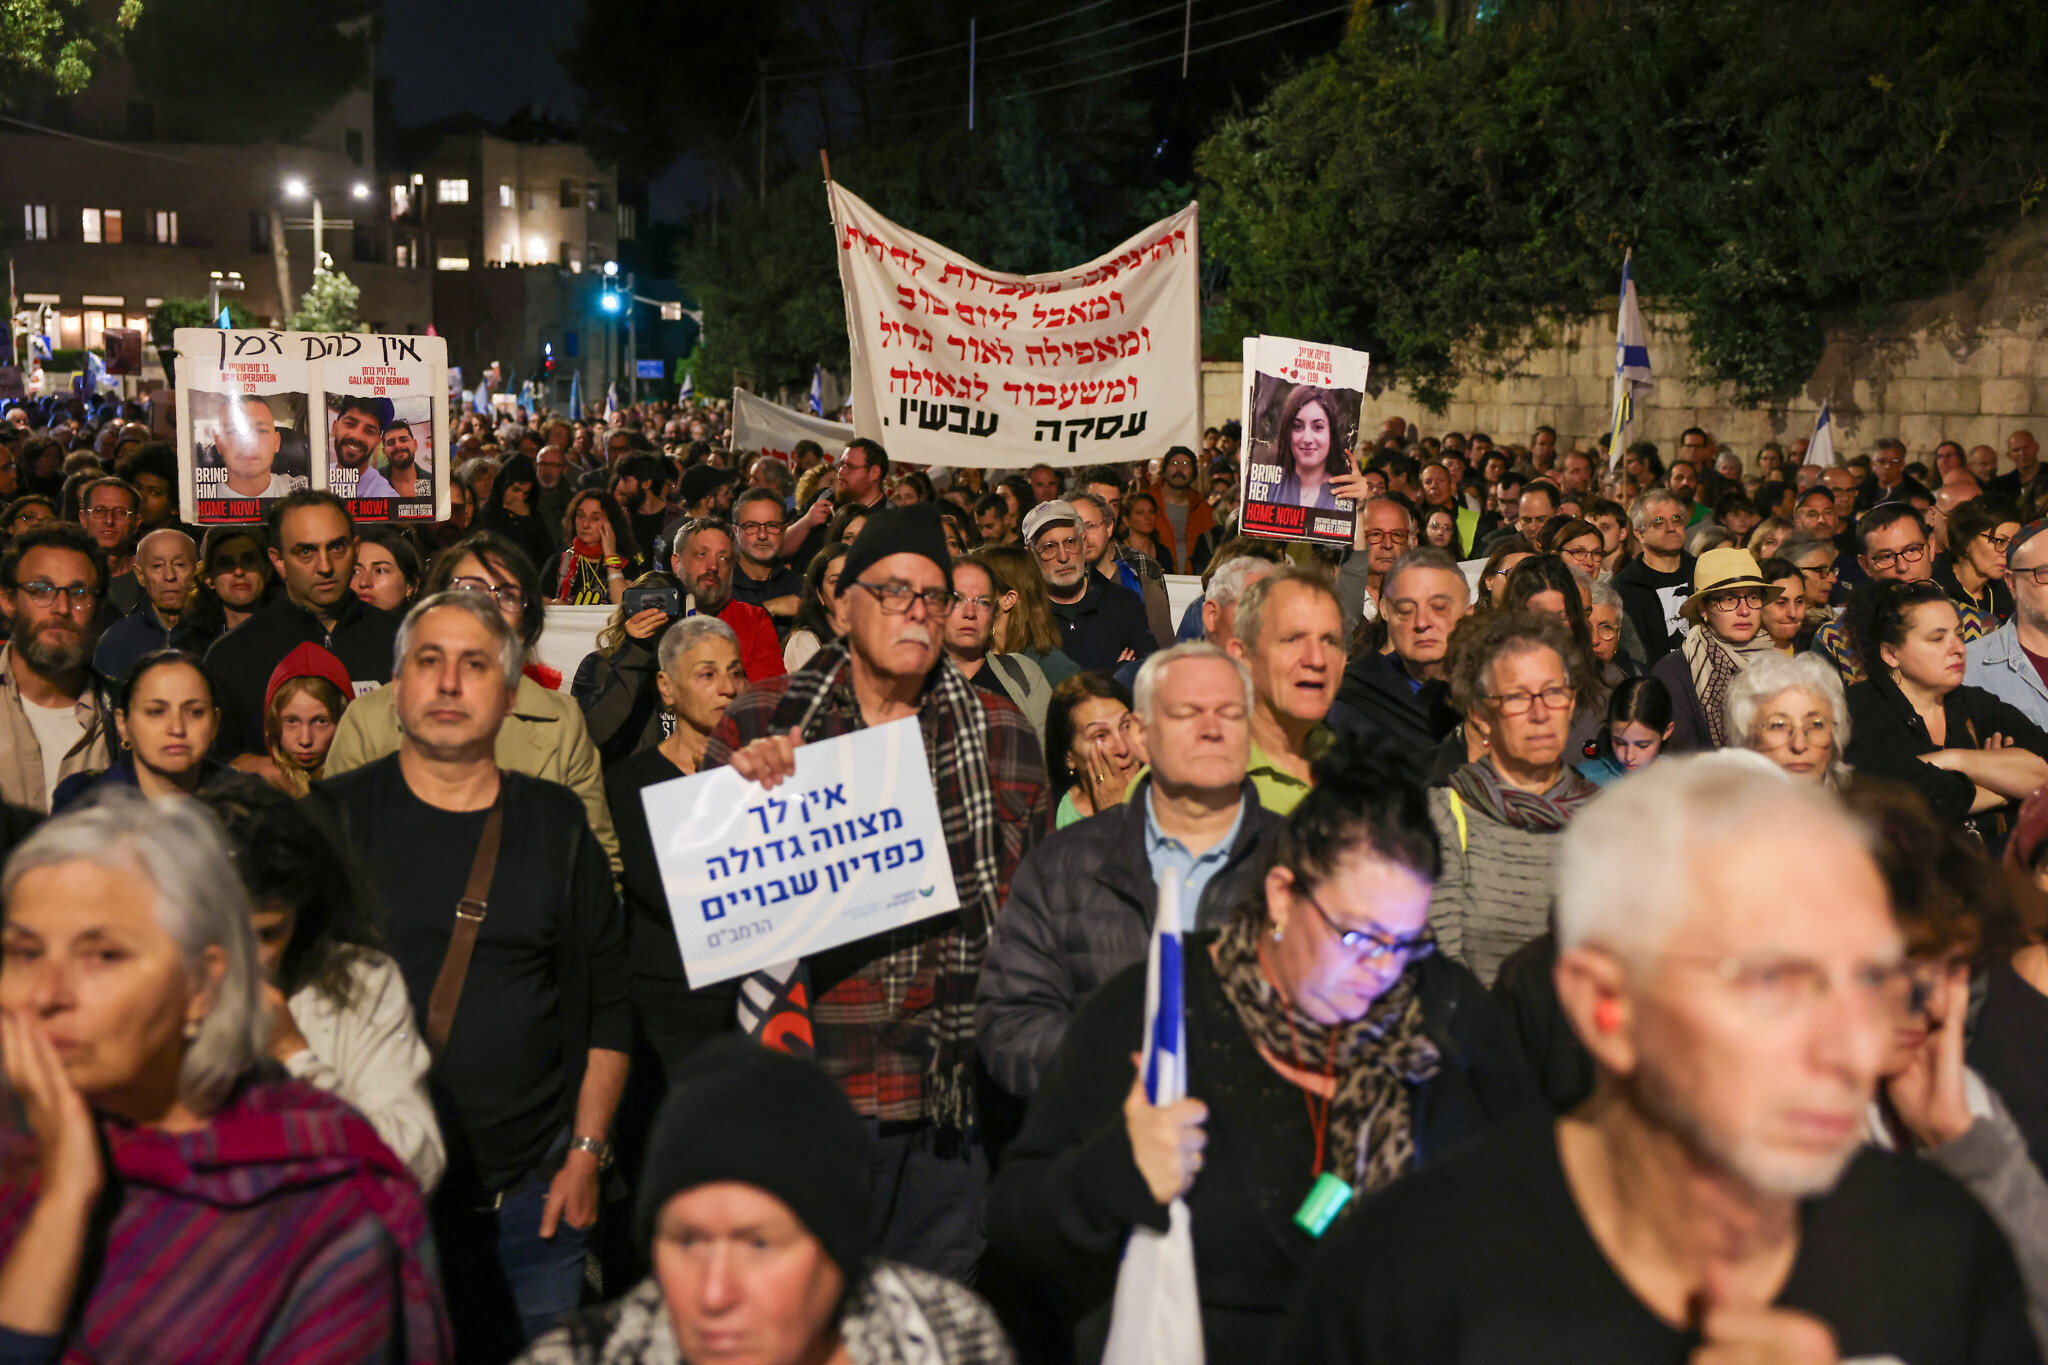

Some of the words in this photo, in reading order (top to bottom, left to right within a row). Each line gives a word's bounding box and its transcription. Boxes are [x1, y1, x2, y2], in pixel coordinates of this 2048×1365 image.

[897, 284, 949, 316] טוב
[1033, 291, 1124, 328] ומאבל
[955, 301, 1017, 330] ליום
[880, 311, 934, 352] גדול
[1026, 326, 1151, 366] ומאפילה
[218, 331, 283, 370] זמן
[301, 334, 361, 360] להם
[377, 336, 422, 366] אין
[947, 334, 1013, 365] לאור
[236, 373, 276, 383] KUPERSHTEIN
[1295, 358, 1315, 370] KARINA
[1316, 361, 1332, 374] ARIEV
[243, 383, 256, 393] (22)
[348, 376, 362, 385] GALI
[363, 376, 375, 385] AND
[376, 376, 386, 385] ZIV
[386, 377, 410, 386] BERMAN
[373, 386, 386, 396] (26)
[890, 361, 988, 402] לגאולה
[1003, 376, 1138, 410] ומשעבוד
[1035, 411, 1147, 452] עסקה
[196, 467, 228, 483] BRING
[329, 468, 359, 483] BRING
[1251, 463, 1283, 484] BRING
[197, 483, 217, 498] HIM
[329, 484, 357, 499] THEM
[1248, 482, 1269, 502] HER
[198, 500, 228, 516] HOME
[230, 498, 260, 516] NOW!
[360, 498, 388, 515] NOW!
[1246, 503, 1275, 524] HOME
[1275, 507, 1306, 527] NOW!
[749, 798, 787, 834] לך
[801, 784, 846, 822] אין
[810, 808, 902, 852] מצווה
[707, 836, 804, 880] גדולה
[826, 839, 924, 892] כפדיון
[701, 870, 817, 921] שבויים
